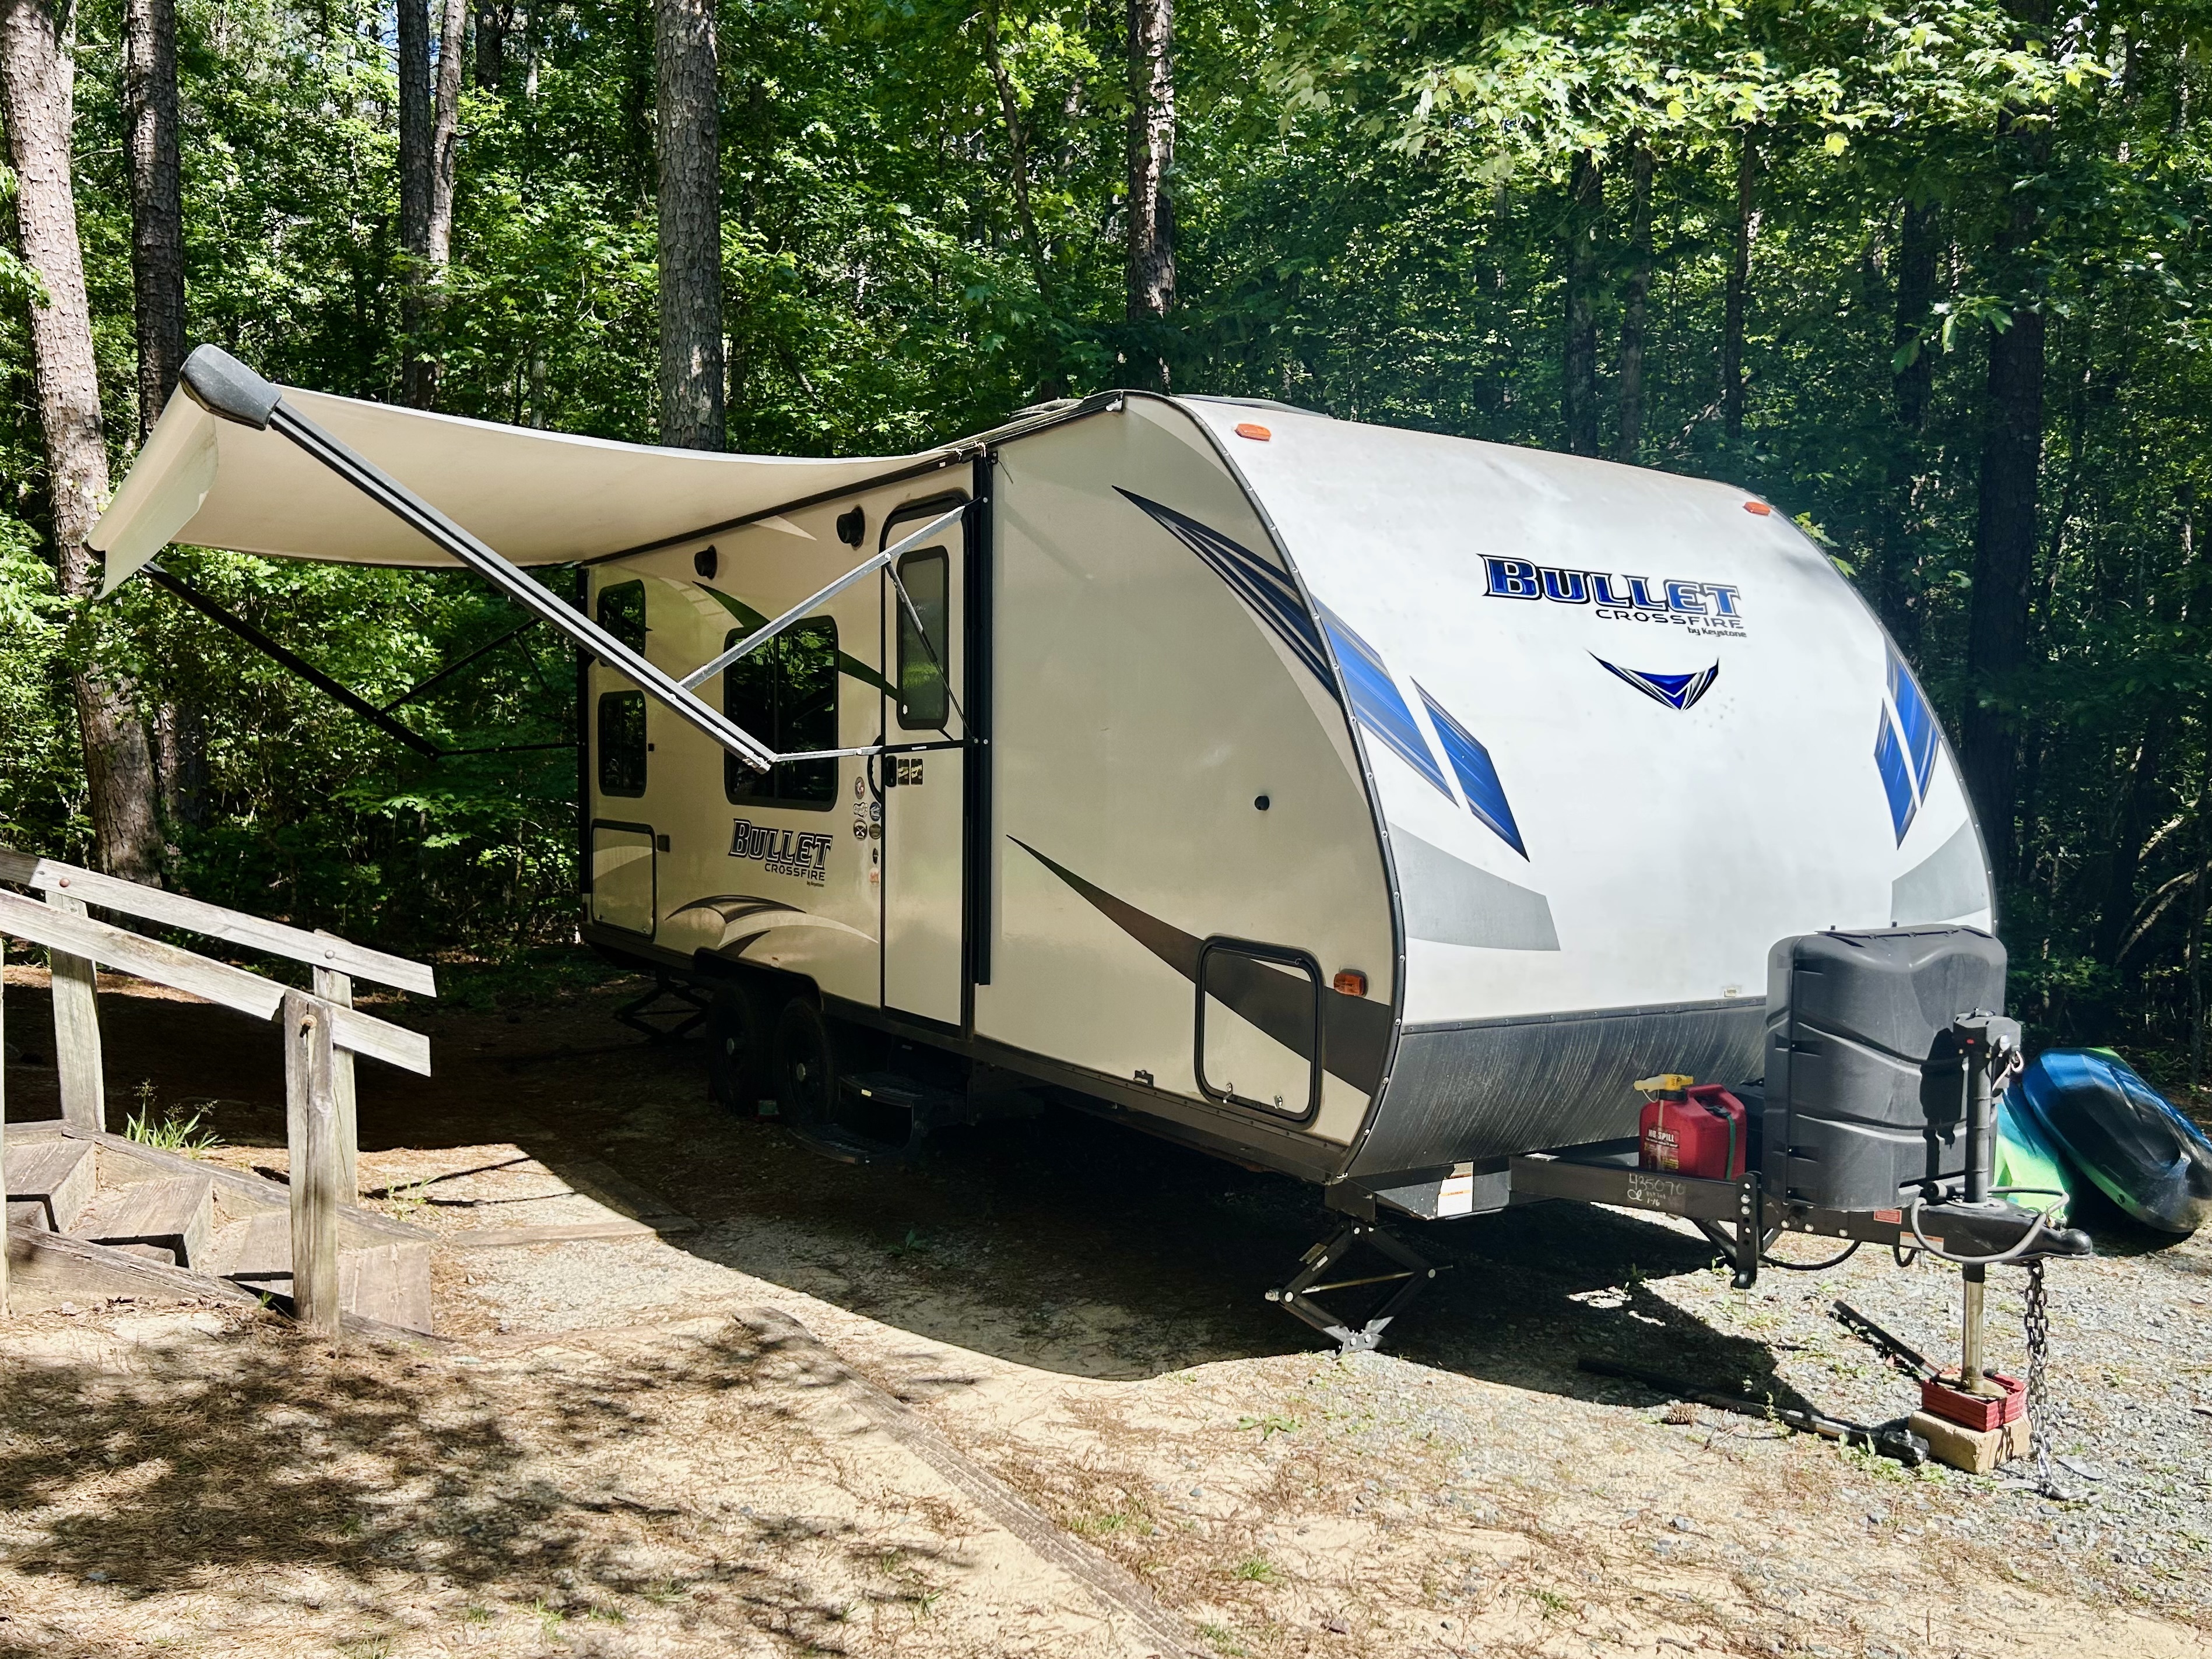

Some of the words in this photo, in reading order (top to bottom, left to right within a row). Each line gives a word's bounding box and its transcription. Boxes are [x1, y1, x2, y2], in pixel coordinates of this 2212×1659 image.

[1476, 553, 1741, 617] BULLET
[1596, 609, 1744, 629] CROSSFIRE
[1687, 626, 1701, 635] by
[1701, 628, 1747, 638] Keystone
[728, 818, 833, 870] BULLET
[764, 863, 826, 881] CROSSFIRE
